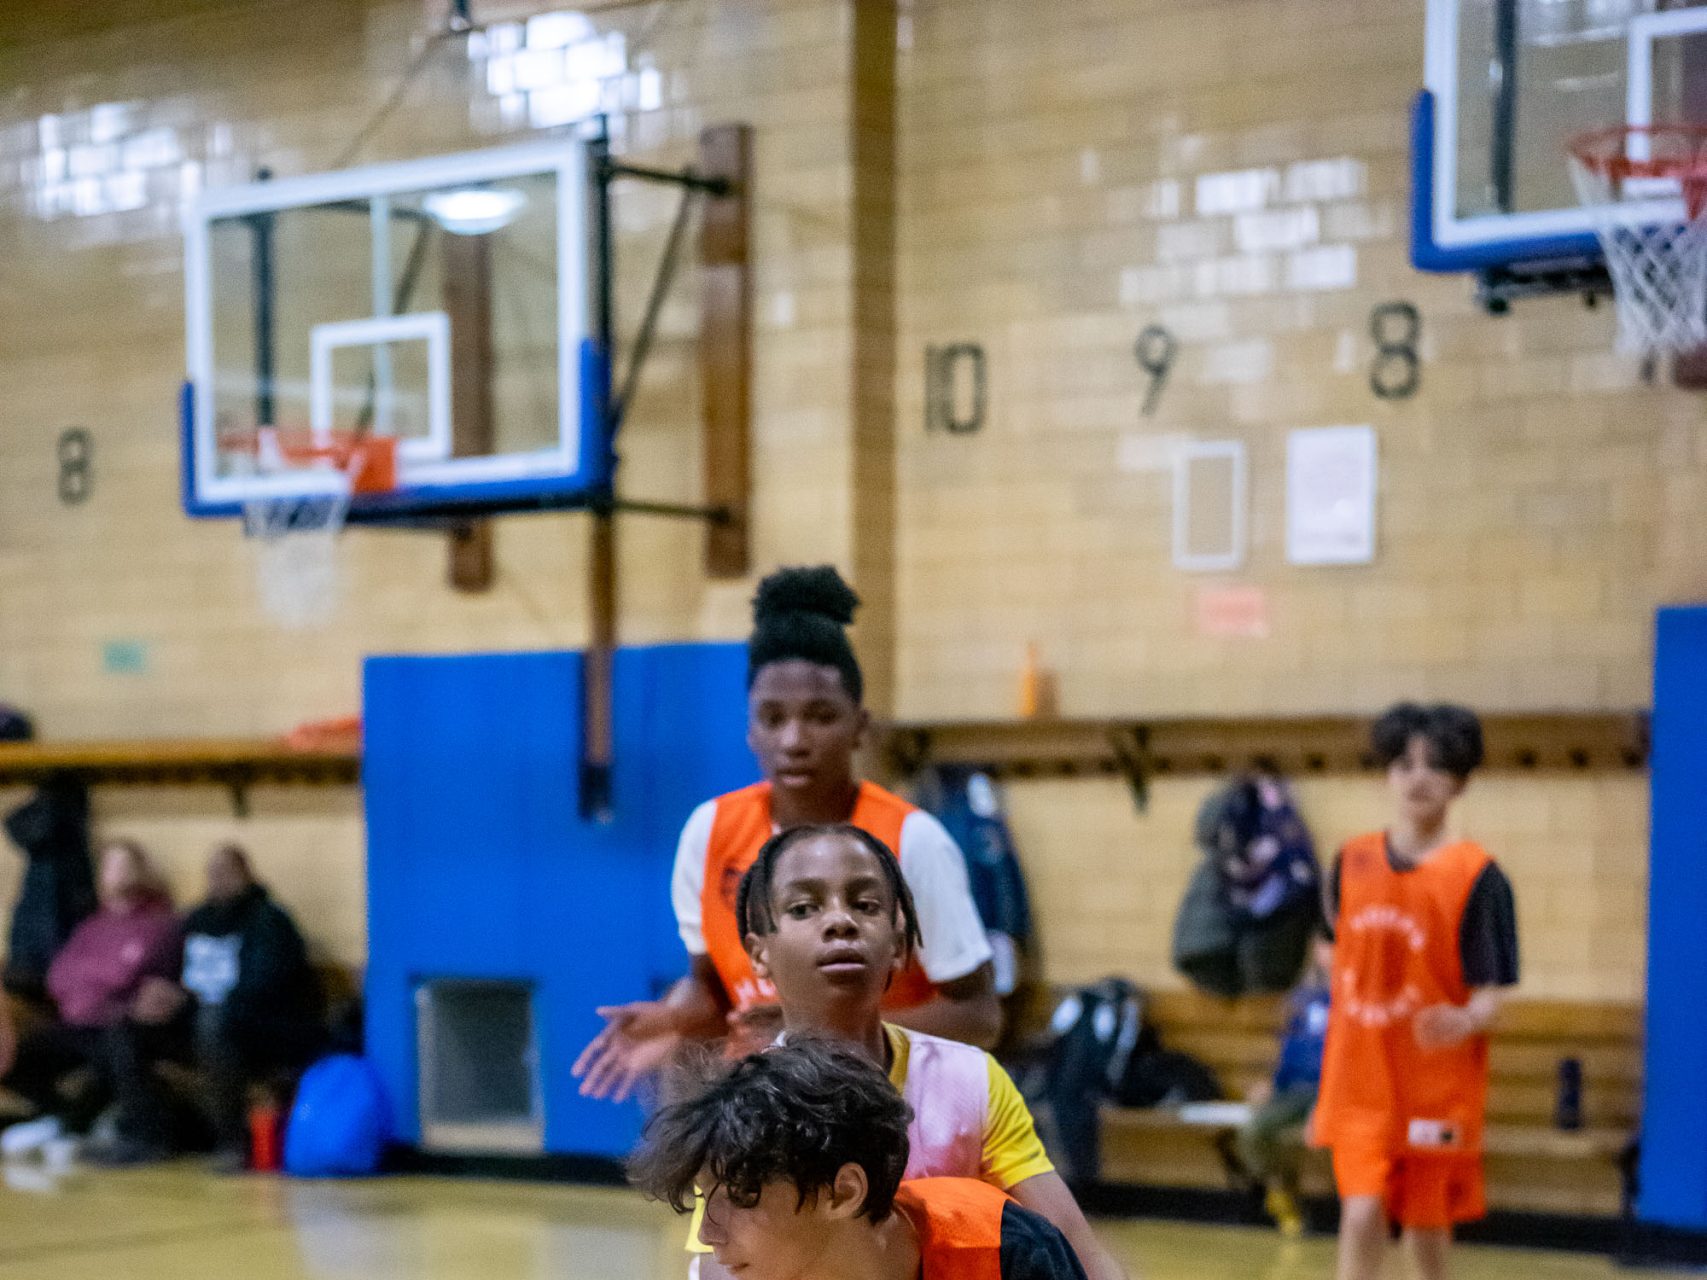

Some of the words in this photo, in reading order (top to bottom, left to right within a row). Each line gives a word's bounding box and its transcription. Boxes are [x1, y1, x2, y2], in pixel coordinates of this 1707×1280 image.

[924, 343, 988, 434] 10
[1134, 323, 1176, 416] 9
[1368, 301, 1421, 399] 8
